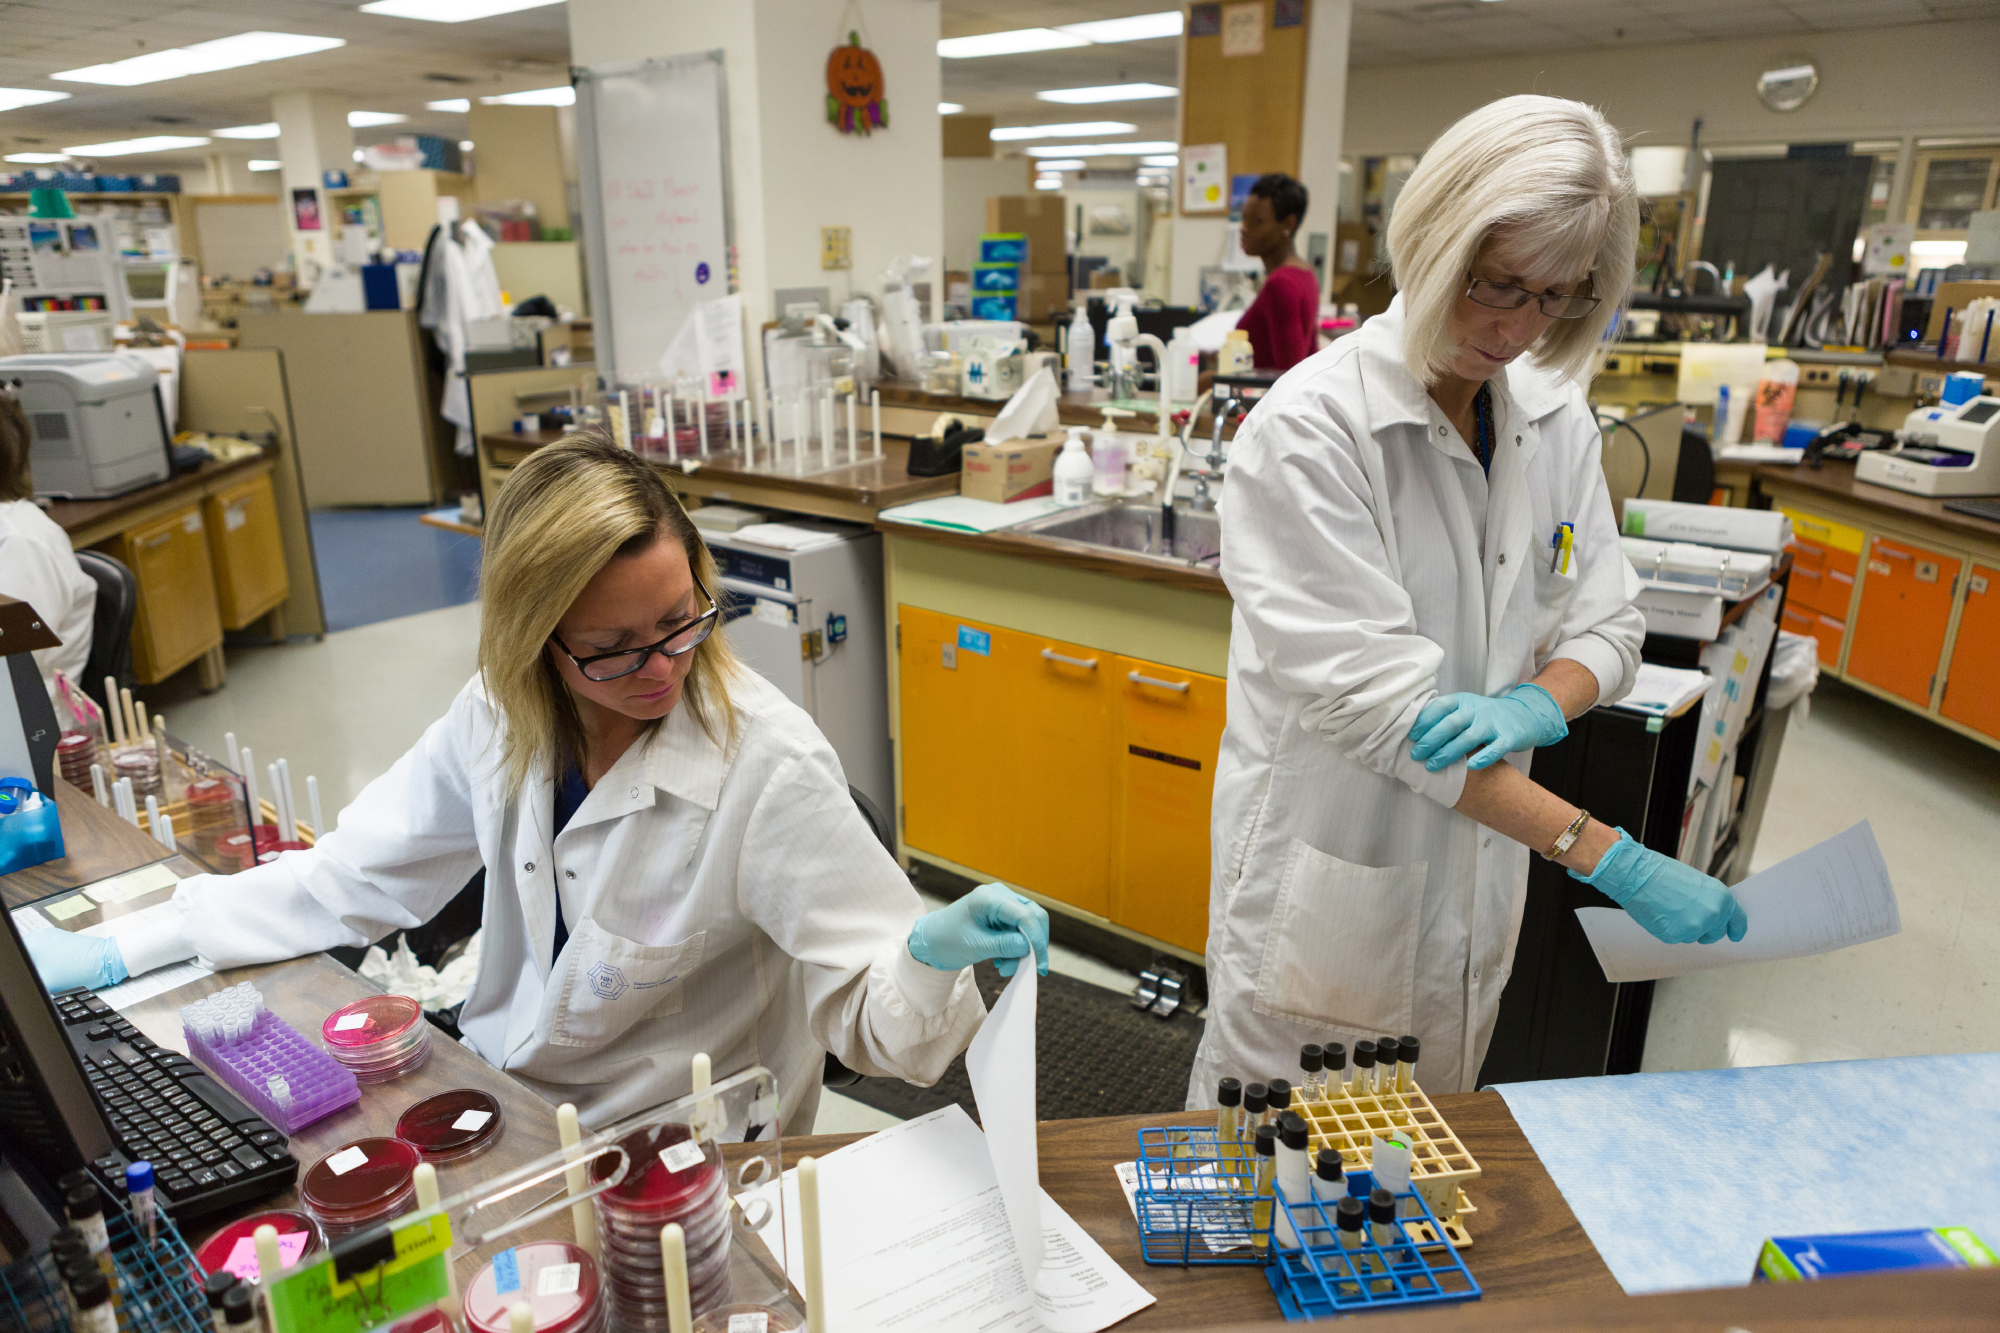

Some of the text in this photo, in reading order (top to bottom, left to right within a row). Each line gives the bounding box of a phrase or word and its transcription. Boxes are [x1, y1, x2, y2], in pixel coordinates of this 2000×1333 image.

[1651, 606, 1674, 615] Testing
[1676, 609, 1701, 617] Manual
[600, 975, 613, 984] NIH
